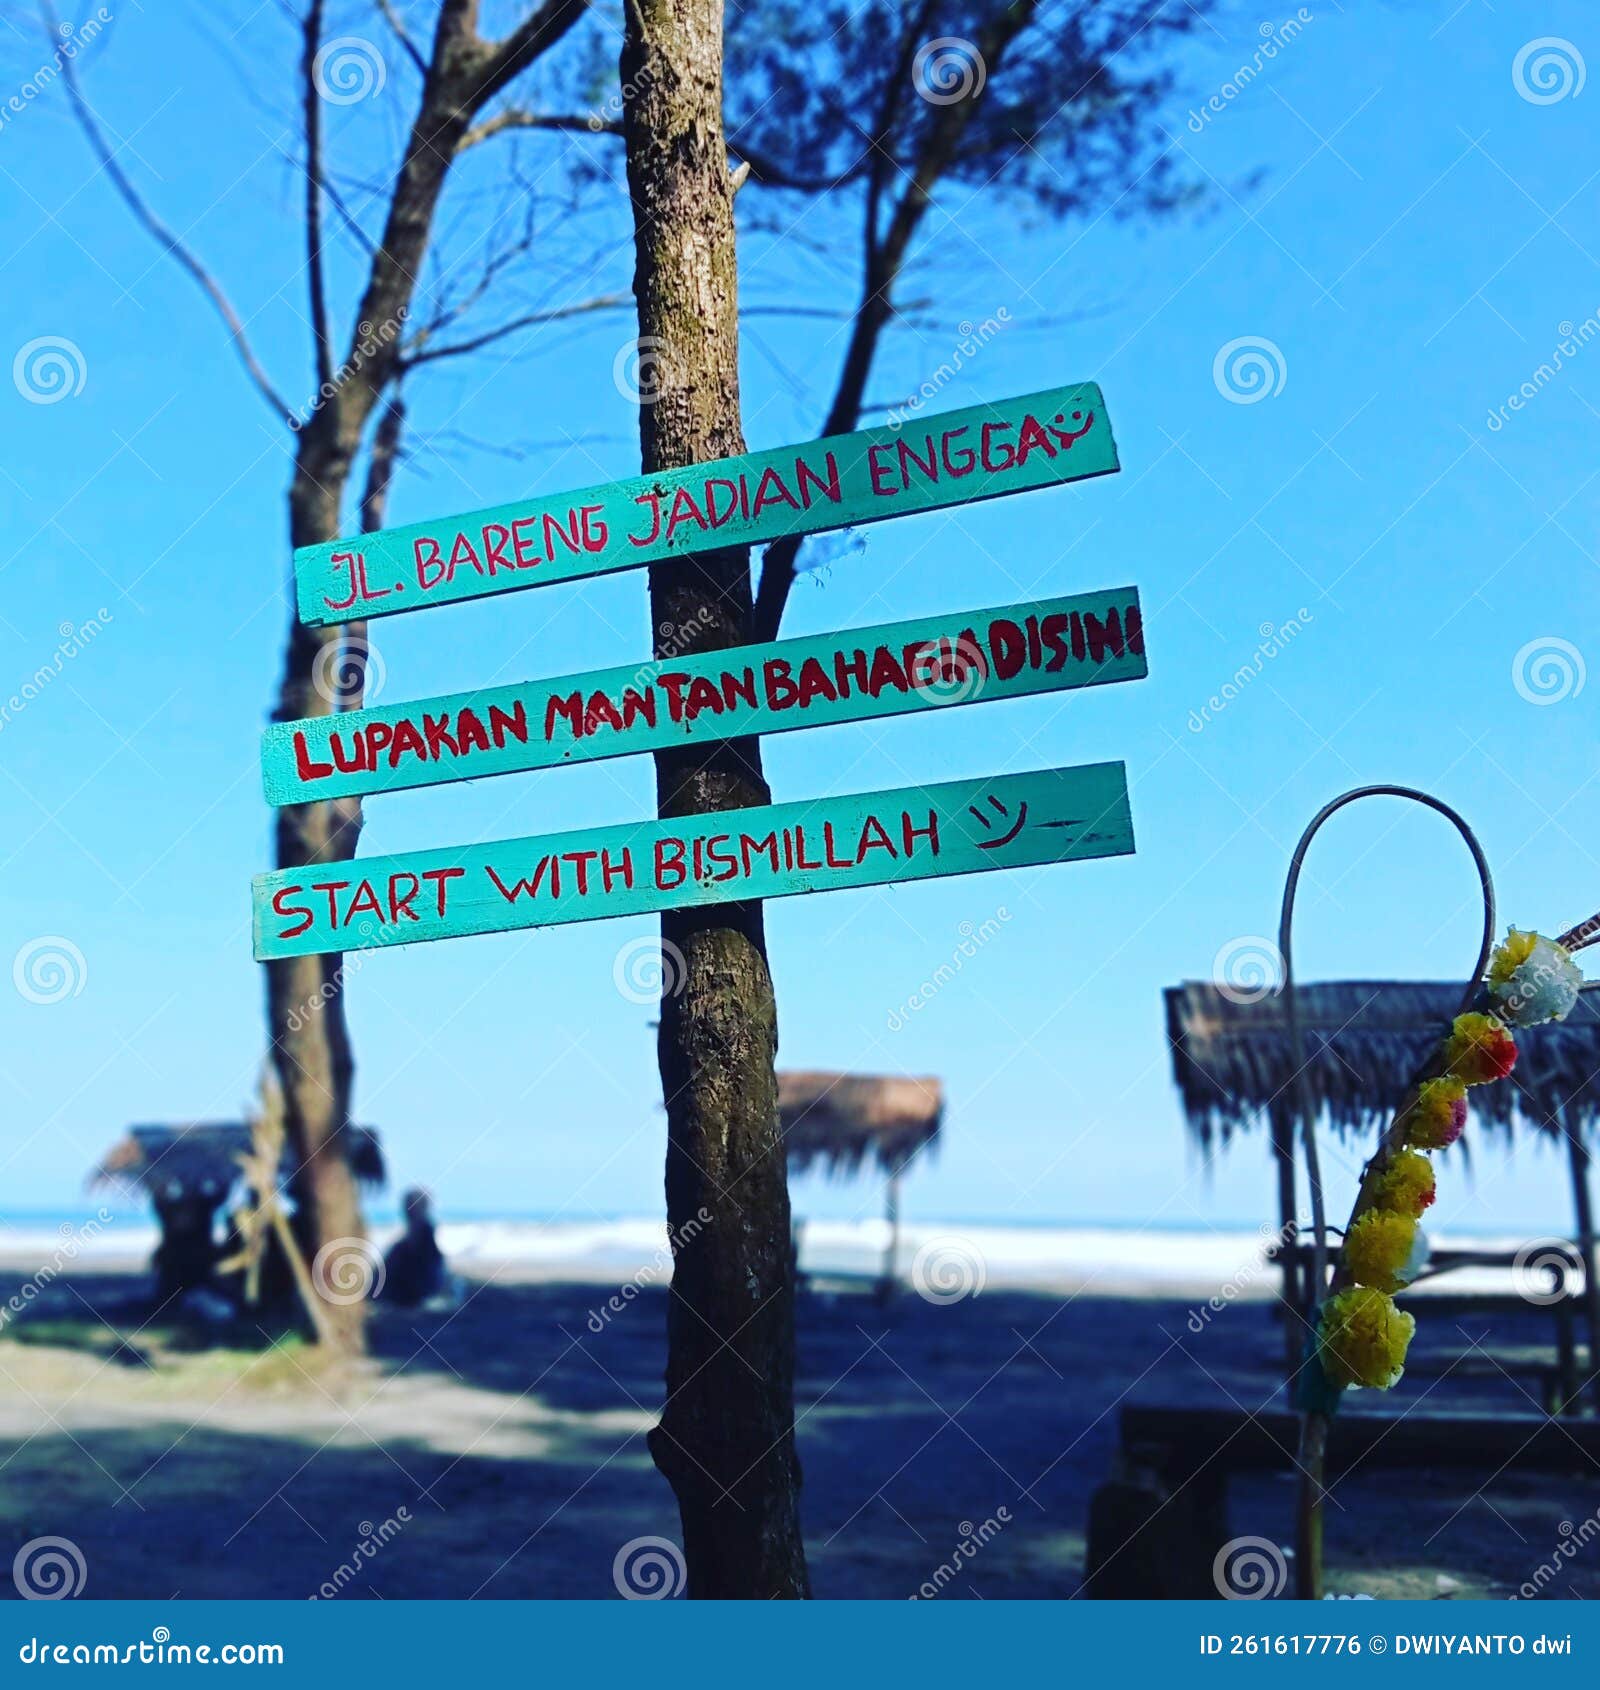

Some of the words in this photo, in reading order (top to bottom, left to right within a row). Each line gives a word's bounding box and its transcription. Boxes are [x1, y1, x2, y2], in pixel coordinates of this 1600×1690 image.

[324, 552, 404, 610] JL.
[413, 504, 609, 590] BARENG
[627, 451, 843, 547] JADIAN
[292, 700, 528, 782] LUPAKAN
[545, 665, 758, 741] MANTAN
[763, 627, 990, 712] BAHAGIA
[272, 867, 465, 939] START
[484, 846, 634, 904] WITH
[653, 807, 940, 892] BISMILLAH
